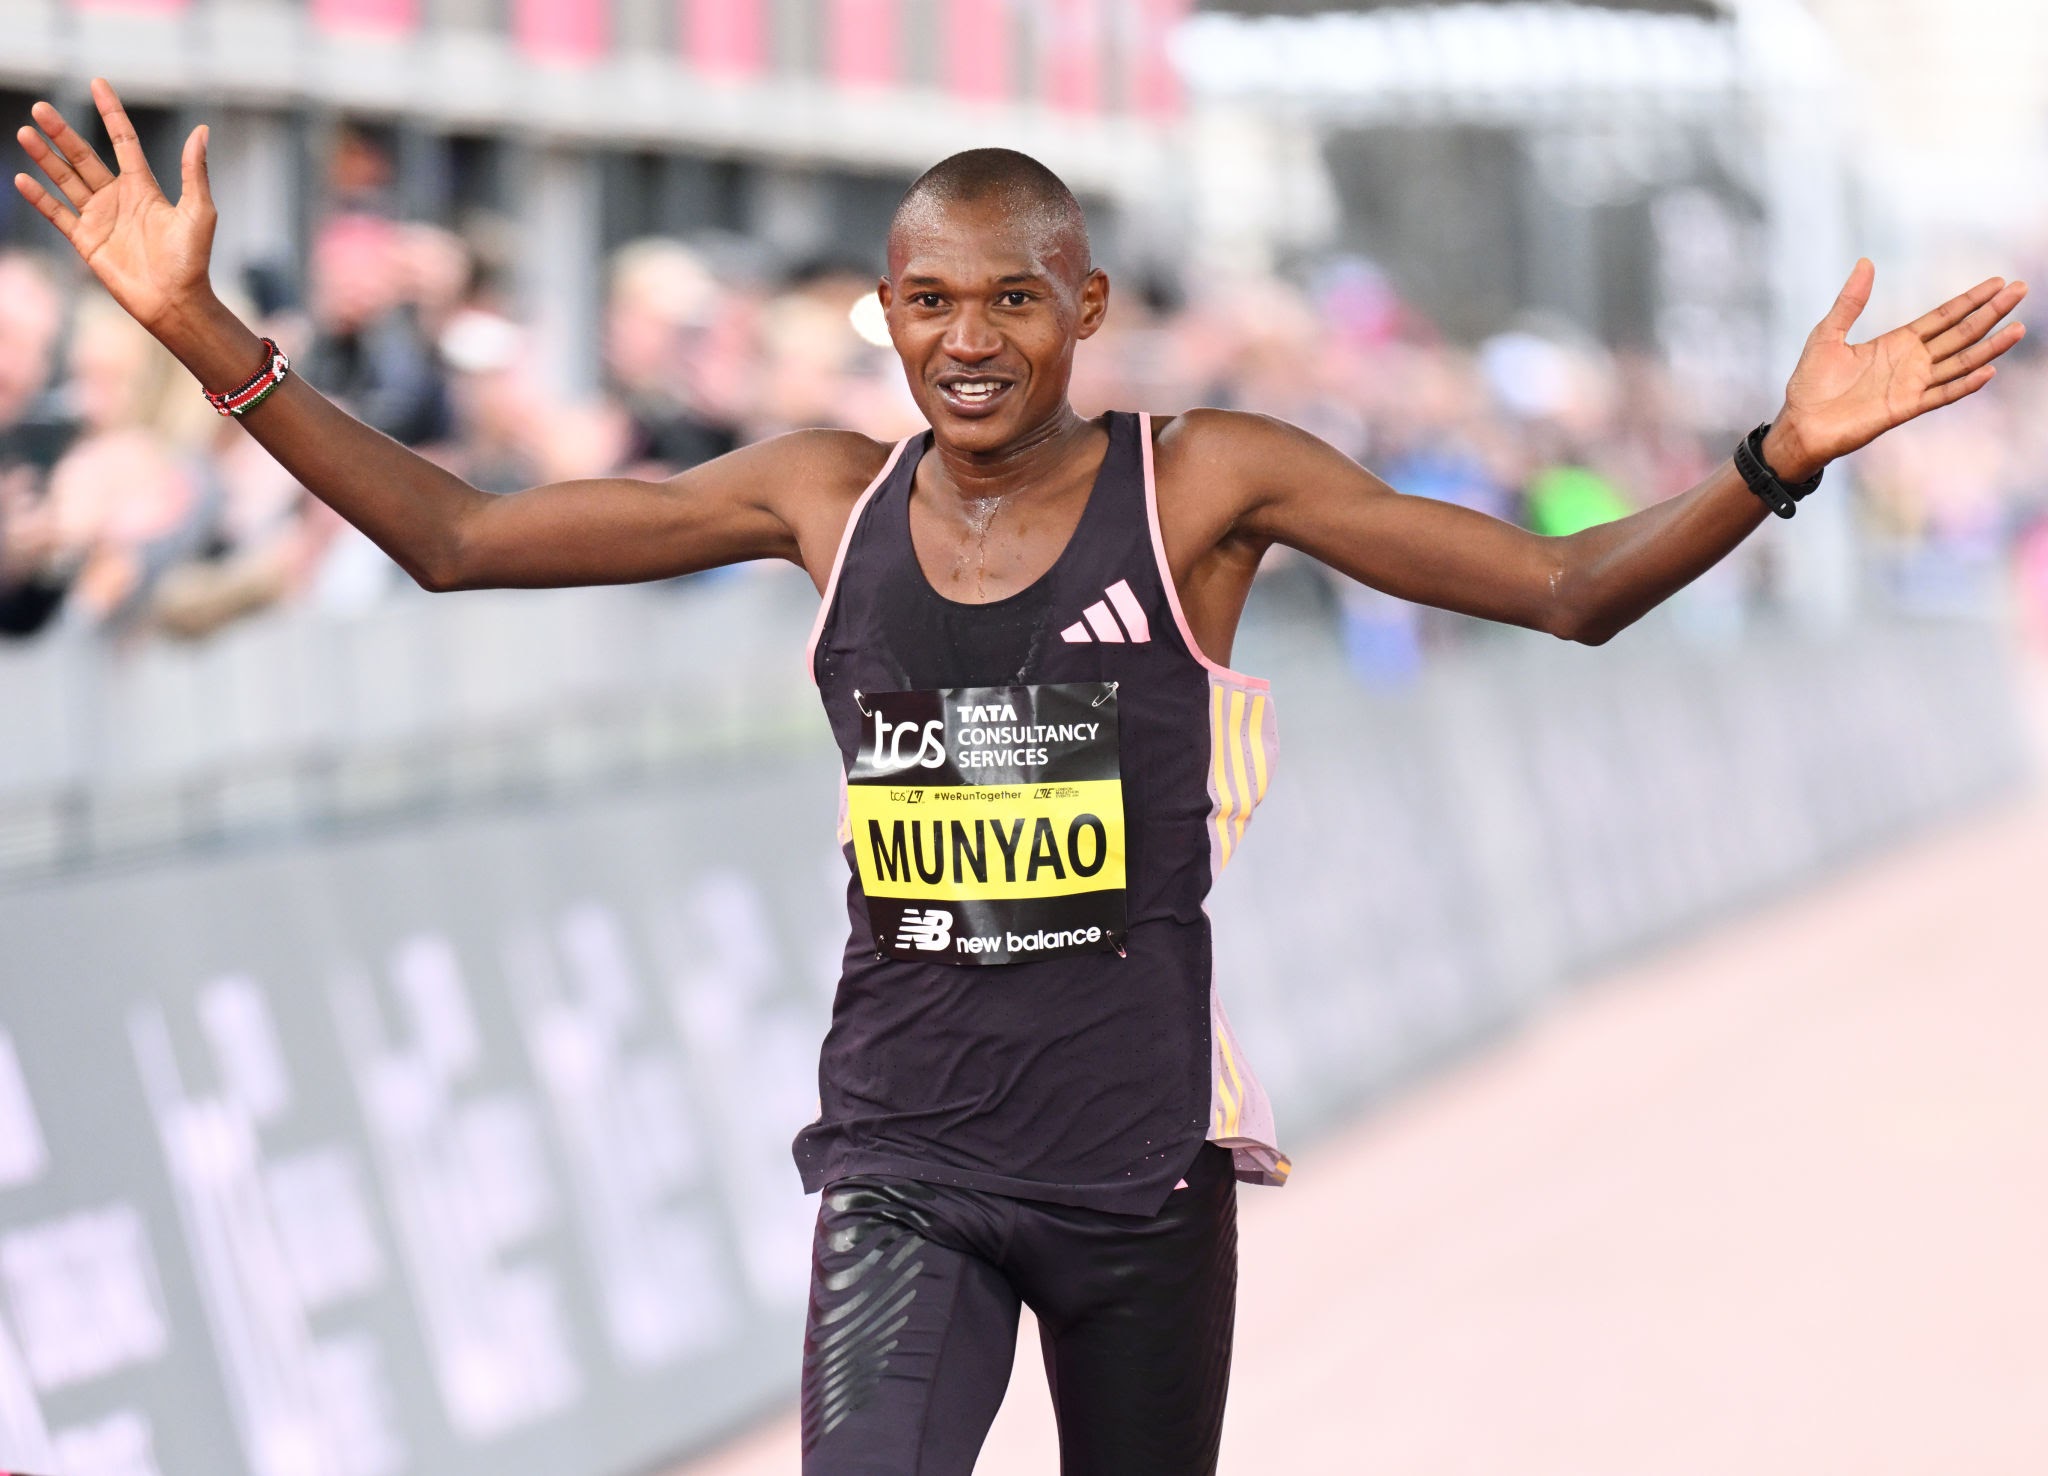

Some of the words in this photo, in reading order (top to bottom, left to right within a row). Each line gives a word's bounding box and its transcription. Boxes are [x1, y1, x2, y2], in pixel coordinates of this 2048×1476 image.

[956, 704, 1018, 723] TATA
[871, 710, 946, 769] tcs
[957, 723, 1100, 746] CONSULTANCY
[958, 748, 1049, 768] SERVICES
[934, 791, 1021, 802] #WeRunTogether
[868, 813, 1107, 885] MUNYAO
[894, 908, 954, 951] NB
[956, 934, 1002, 954] new
[1006, 926, 1101, 952] balance
